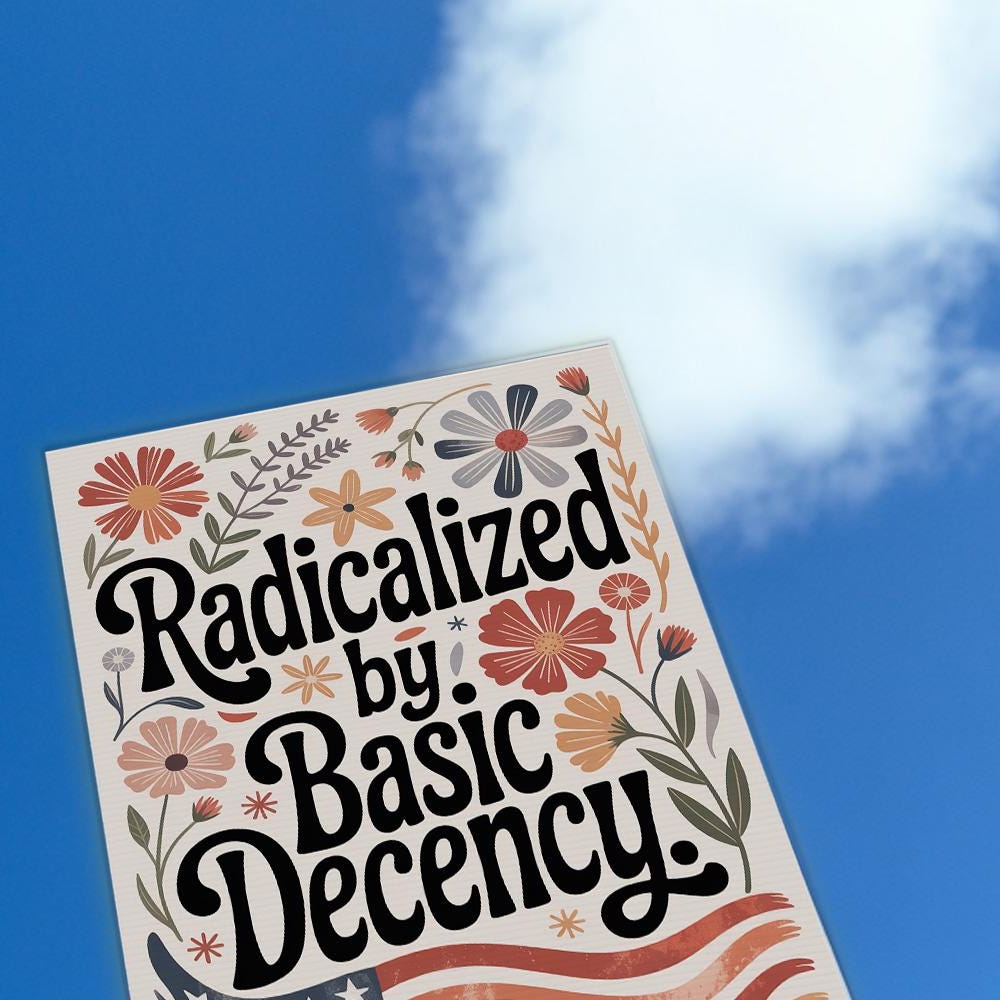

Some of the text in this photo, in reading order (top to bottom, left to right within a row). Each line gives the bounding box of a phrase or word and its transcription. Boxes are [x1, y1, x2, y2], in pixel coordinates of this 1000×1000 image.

[96, 449, 630, 704] Radicalized
[245, 683, 552, 854] Basic
[343, 639, 439, 721] by
[177, 771, 728, 990] Decency.
